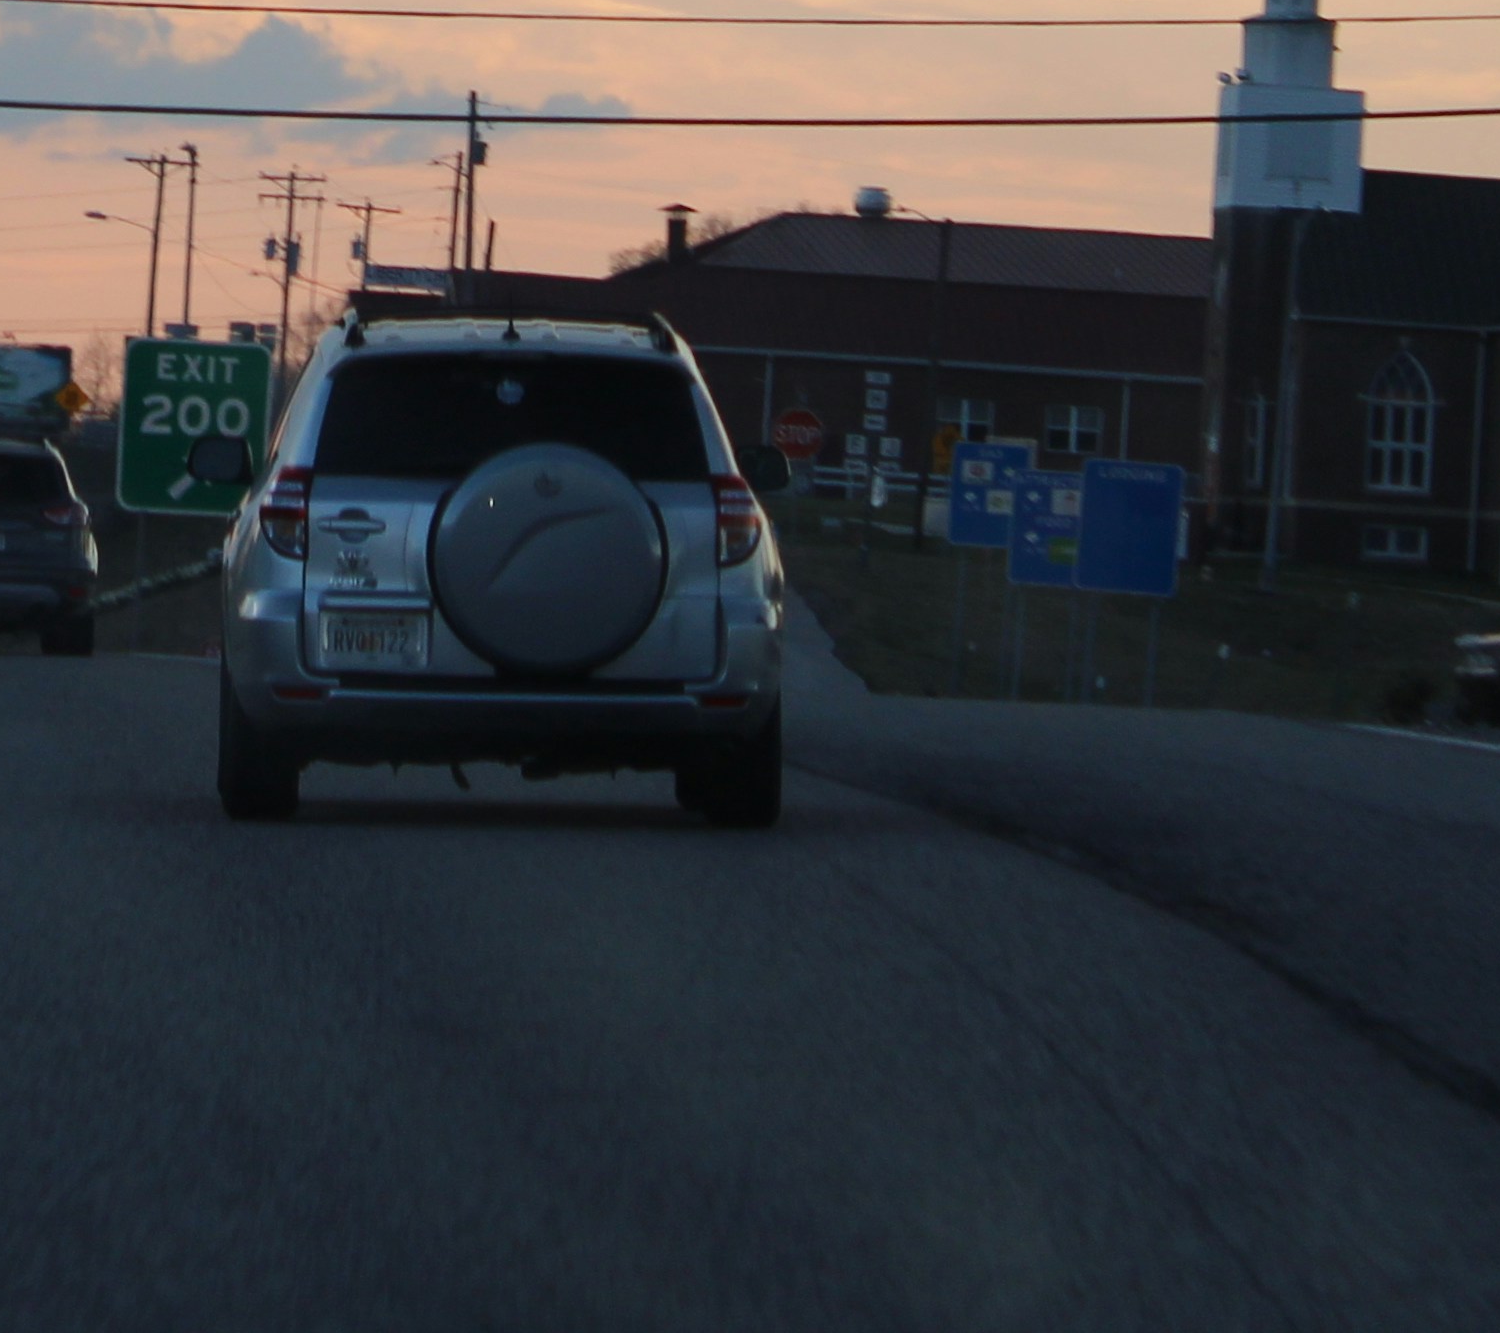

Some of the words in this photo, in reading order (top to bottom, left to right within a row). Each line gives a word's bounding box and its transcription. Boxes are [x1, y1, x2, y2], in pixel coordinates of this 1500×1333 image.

[157, 352, 240, 384] EXIT
[139, 394, 250, 437] 200
[774, 424, 823, 446] STOP
